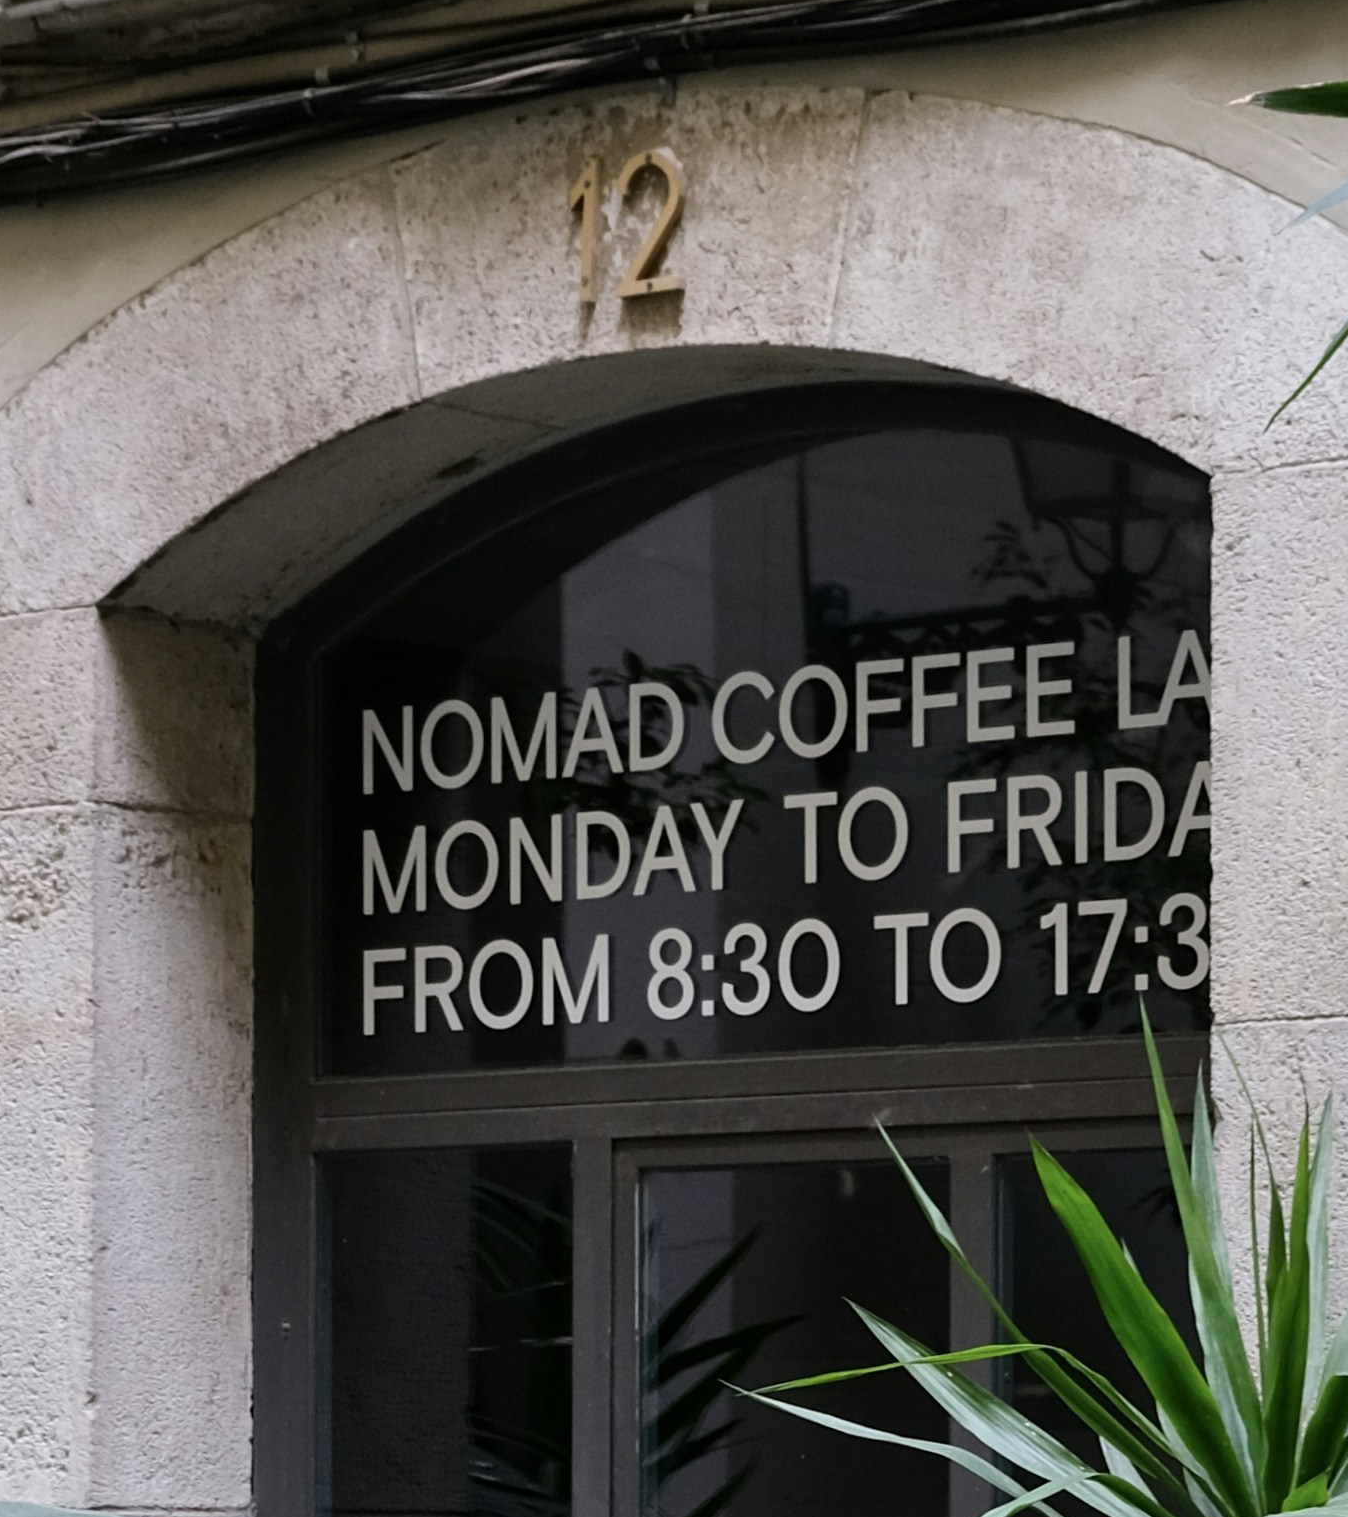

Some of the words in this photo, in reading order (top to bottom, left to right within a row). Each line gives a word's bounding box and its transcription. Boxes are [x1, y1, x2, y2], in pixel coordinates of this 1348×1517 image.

[570, 149, 687, 302] 12
[362, 681, 685, 795] NOMAD
[710, 640, 1076, 765] COFFEE
[362, 798, 745, 916] MONDAY
[783, 785, 909, 885] TO
[362, 933, 611, 1037] FROM
[645, 917, 841, 1022] 8:30
[873, 906, 1003, 1006] TO
